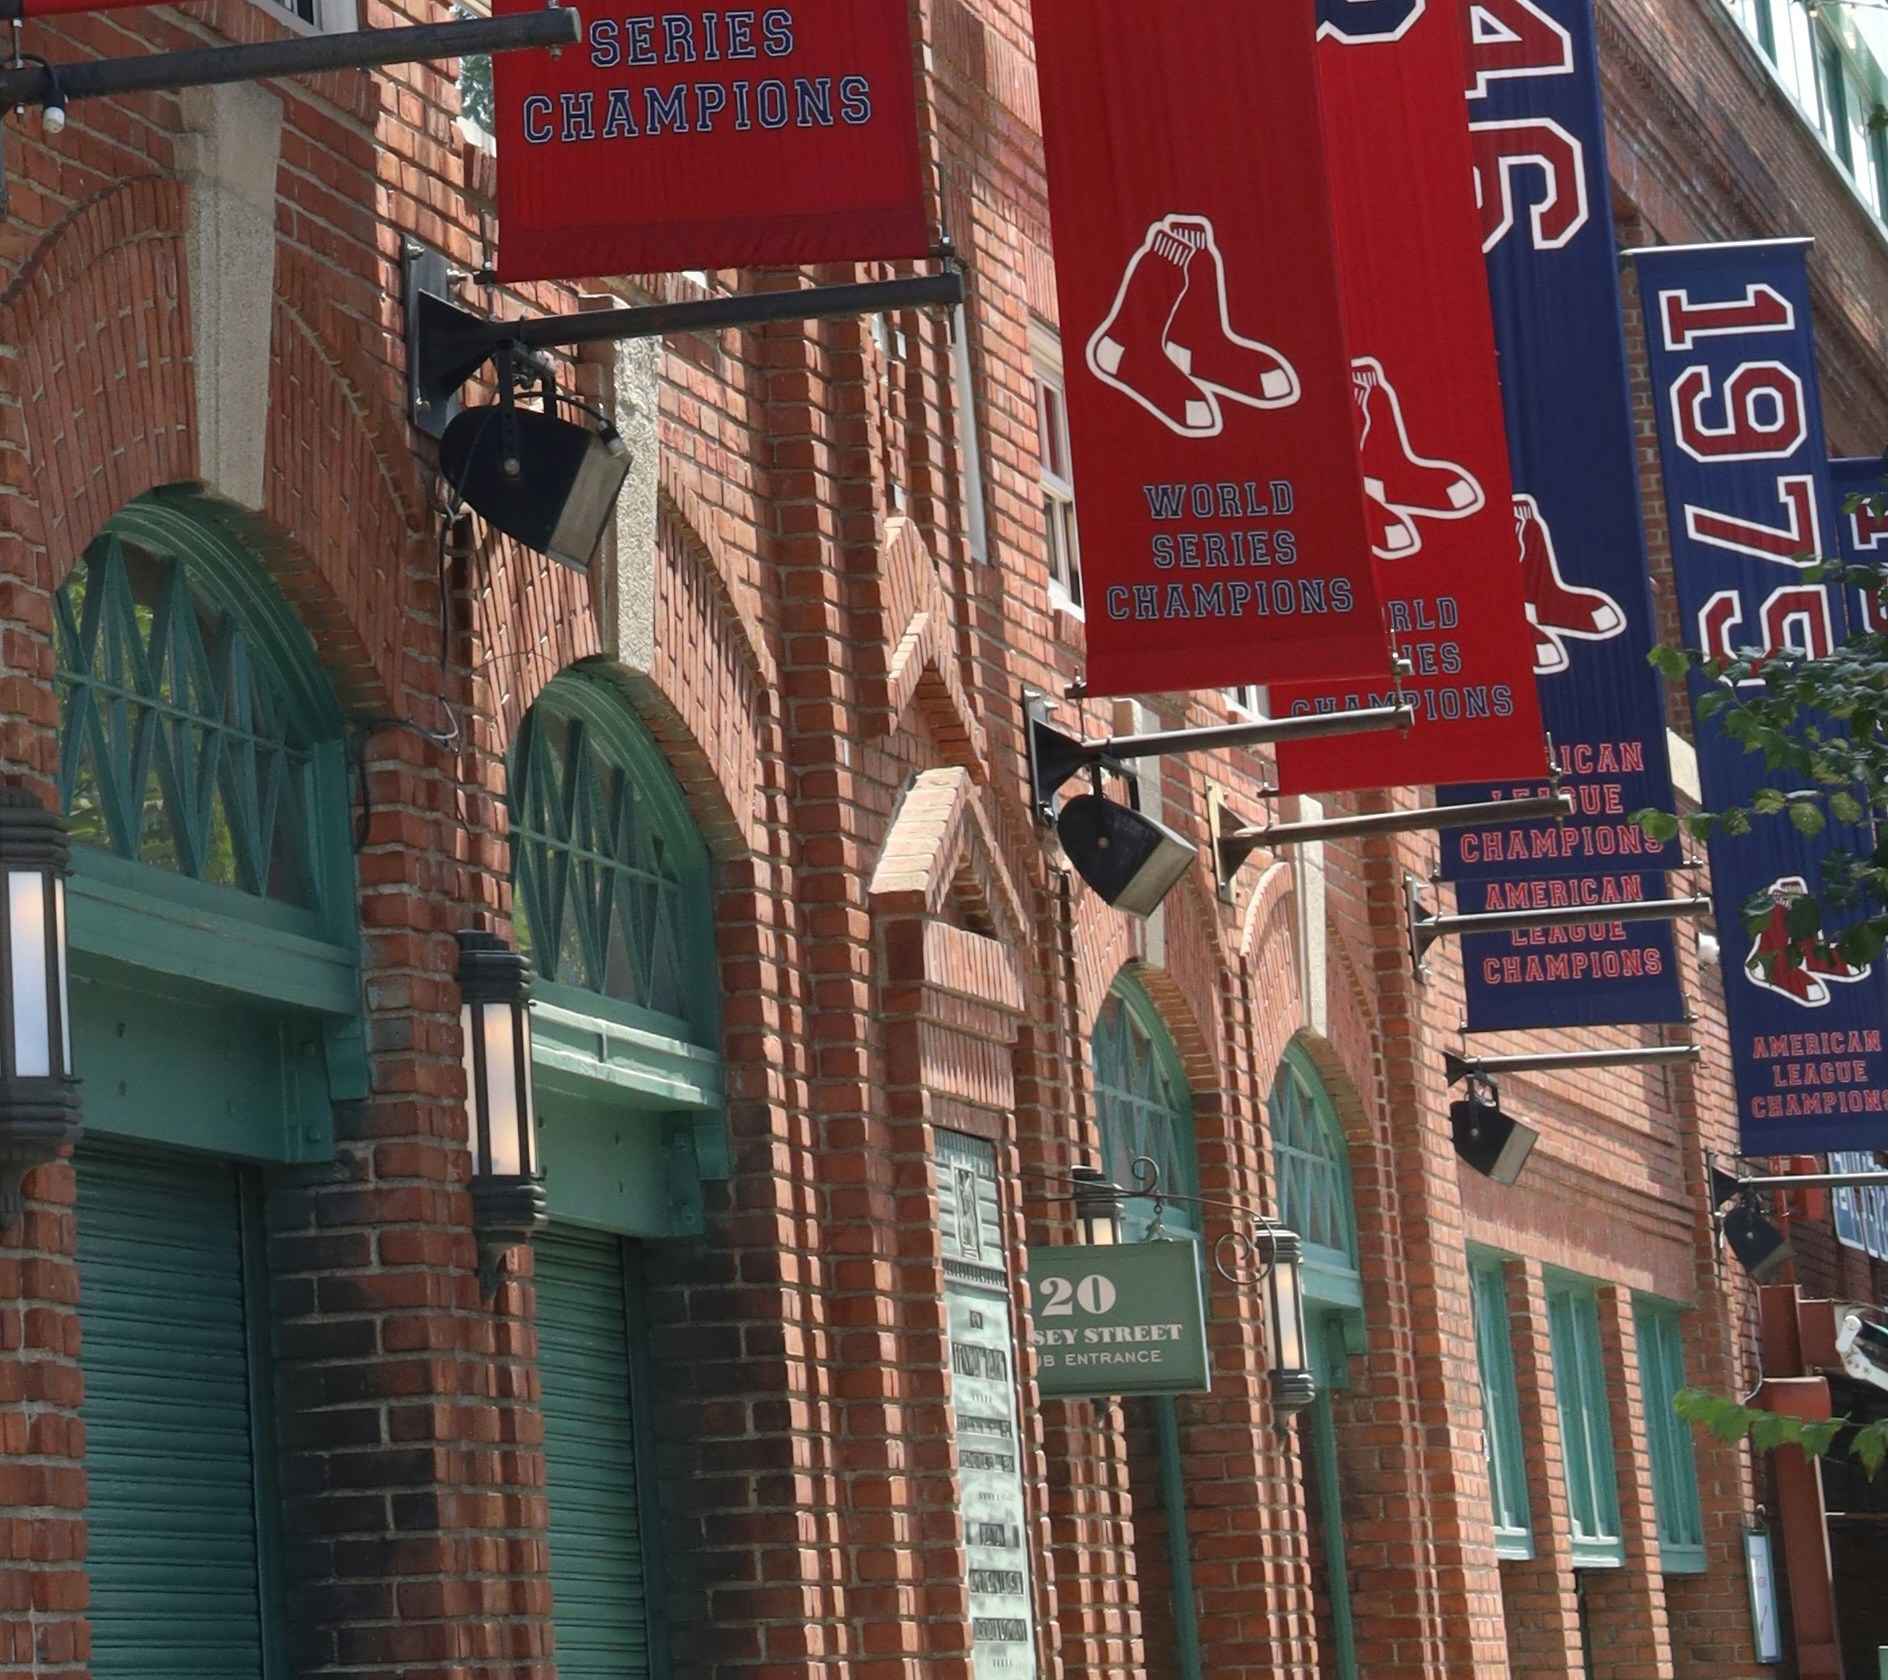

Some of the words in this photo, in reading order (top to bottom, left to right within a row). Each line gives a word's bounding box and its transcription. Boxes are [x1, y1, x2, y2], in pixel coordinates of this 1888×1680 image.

[589, 7, 794, 68] SERIES
[522, 75, 872, 144] CHAMPIONS
[1143, 479, 1295, 520] WORLD
[1658, 283, 1835, 688] 1975
[1151, 530, 1297, 569] SERIES
[1106, 577, 1354, 621] CHAMPIONS
[1388, 596, 1459, 633] RLD
[1484, 874, 1643, 910] AMERICAN
[1511, 920, 1627, 946] LEAGUE
[1482, 947, 1663, 985] CHAMPIONS
[1752, 1029, 1883, 1059] AMERICAN
[1772, 1060, 1869, 1087] LEAGUE
[1038, 1273, 1117, 1318] 20
[1033, 1327, 1079, 1347] SEY
[1083, 1323, 1184, 1345] STREET
[1065, 1349, 1163, 1367] ENTRANCE
